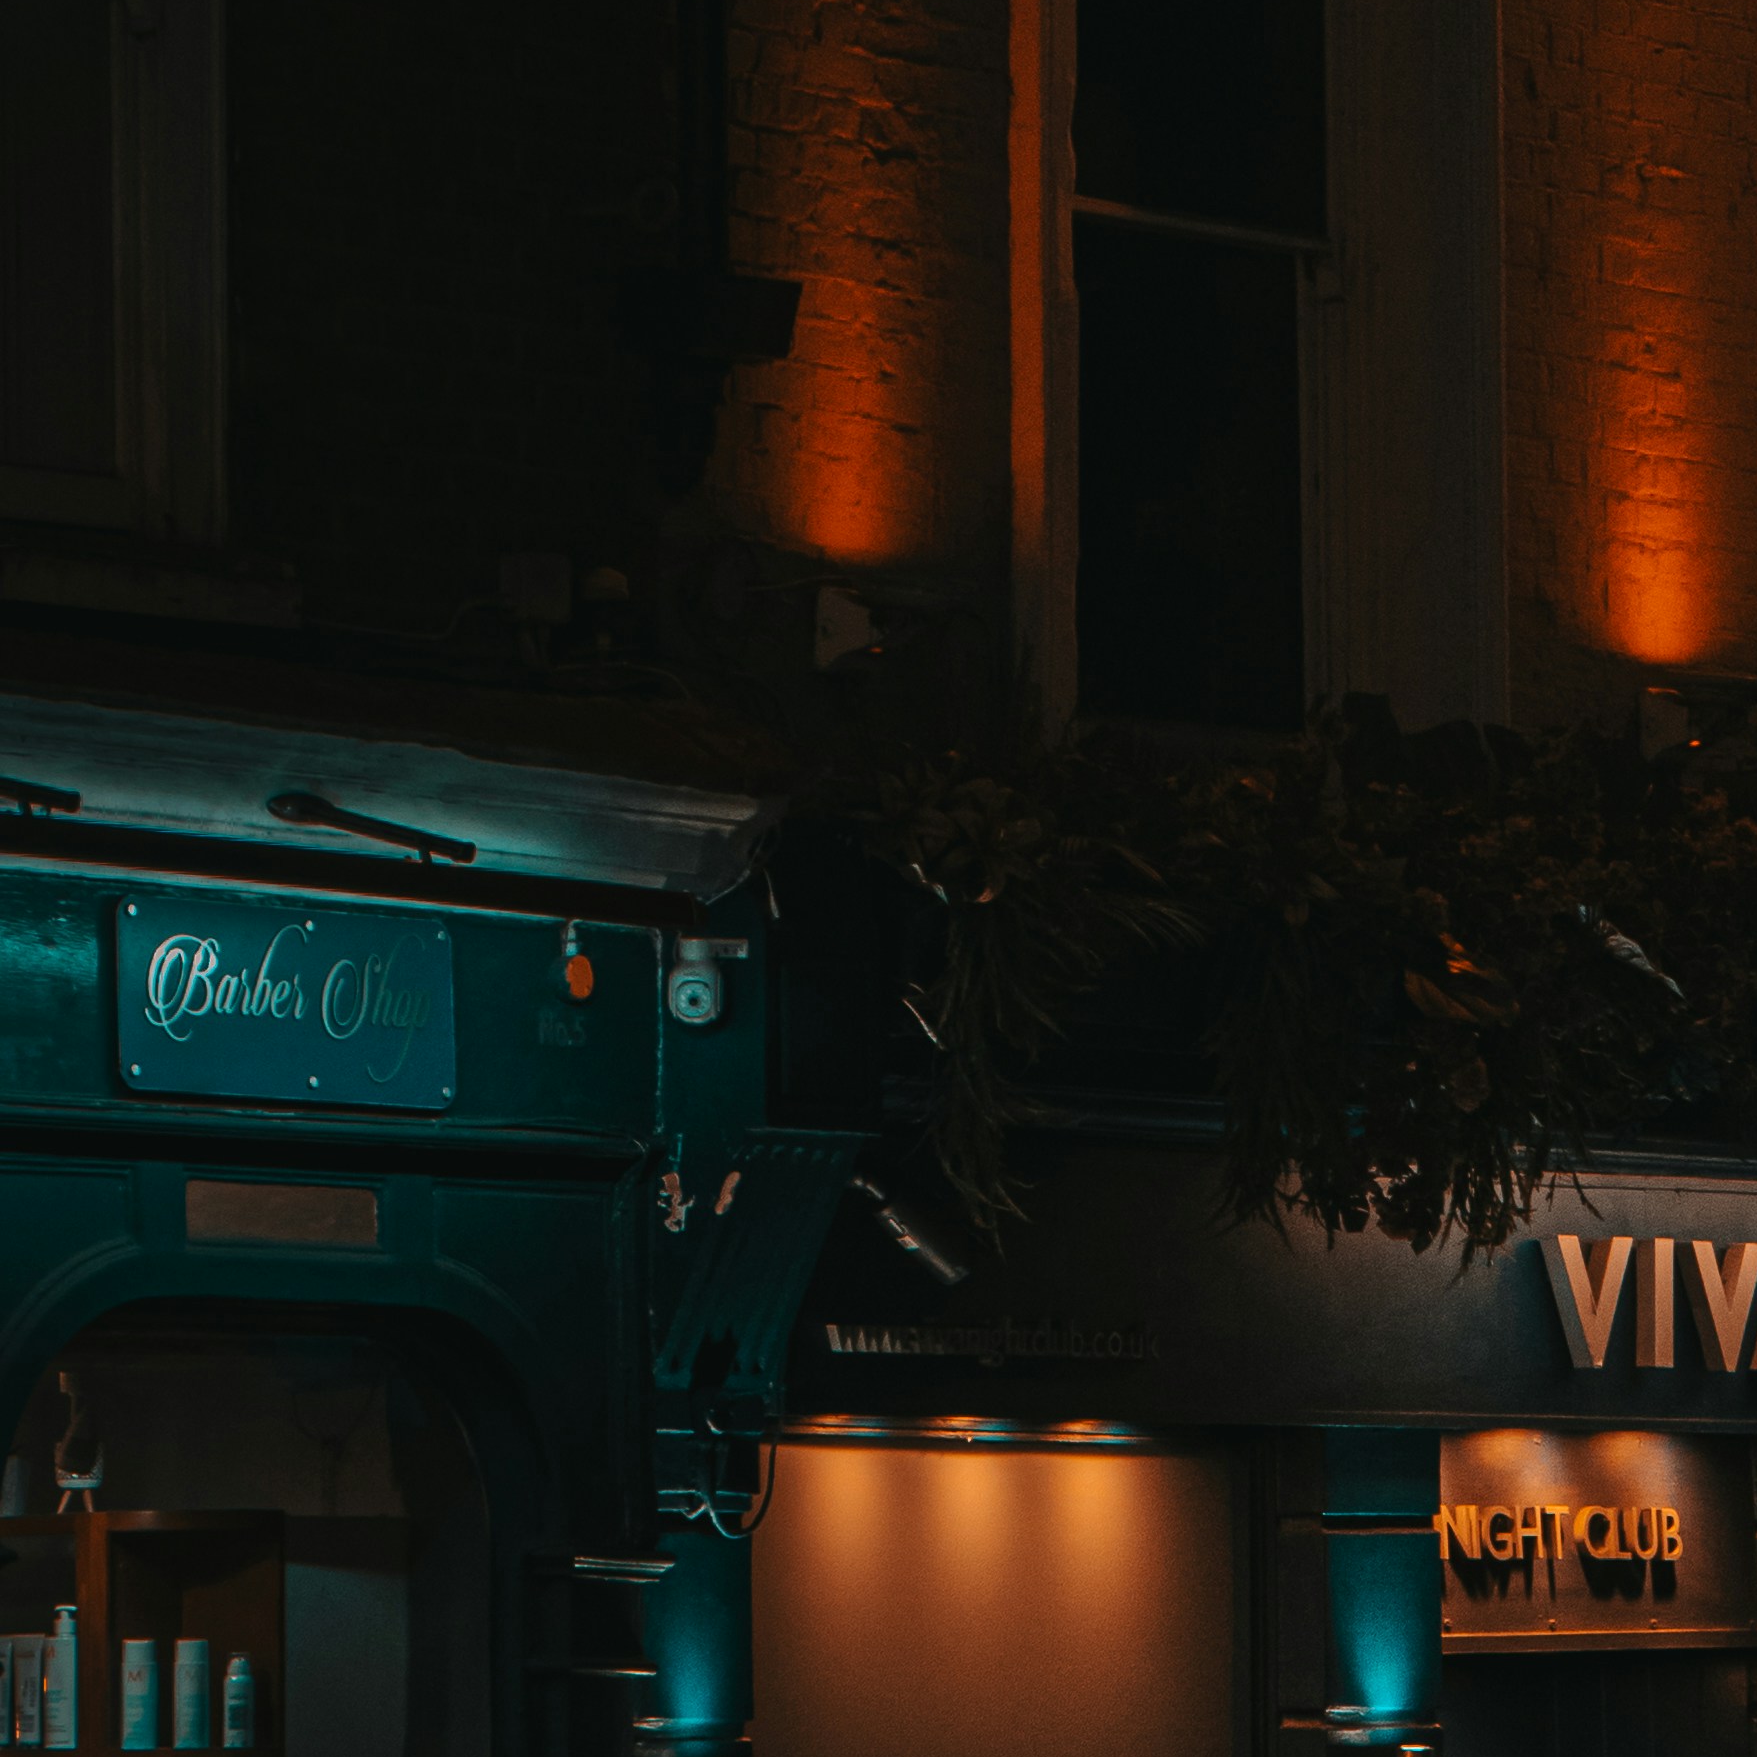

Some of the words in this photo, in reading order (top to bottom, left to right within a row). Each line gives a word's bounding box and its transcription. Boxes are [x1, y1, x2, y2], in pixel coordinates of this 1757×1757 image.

[144, 923, 309, 1041] Barber
[321, 934, 430, 1082] Shop
[1433, 1504, 1569, 1560] NIGHT
[1574, 1504, 1684, 1560] CLUB
